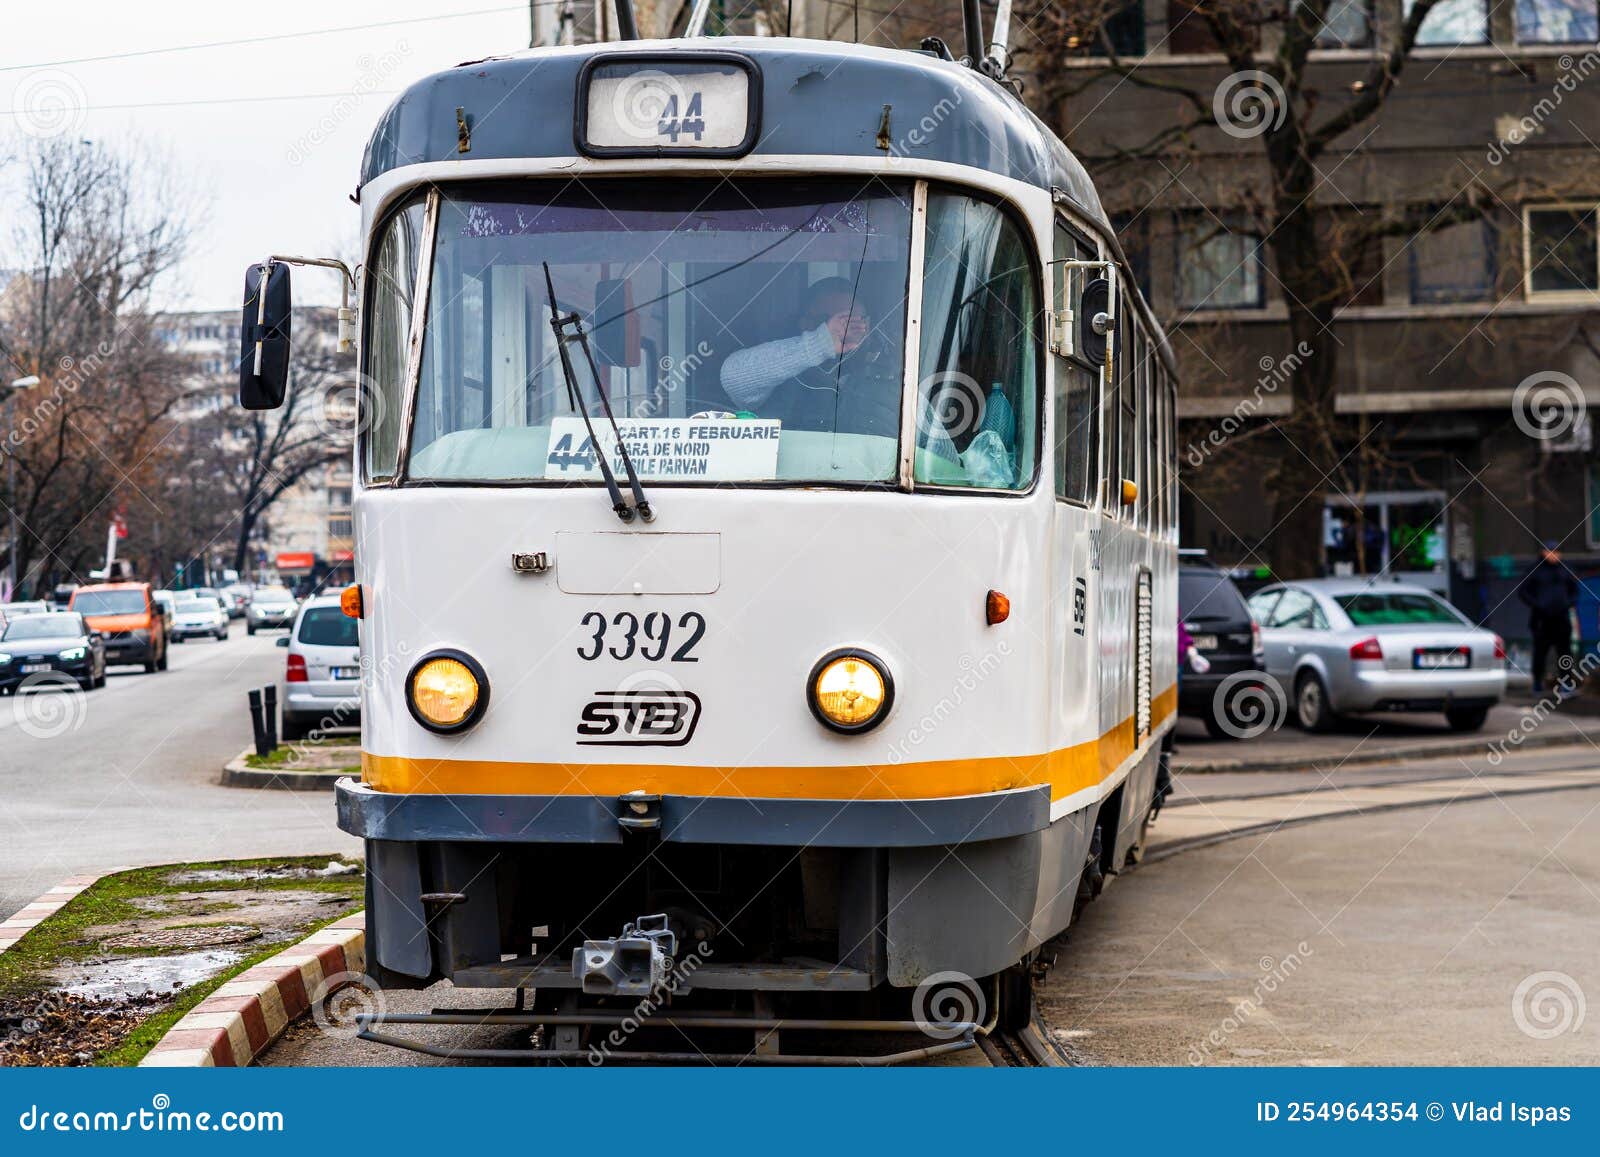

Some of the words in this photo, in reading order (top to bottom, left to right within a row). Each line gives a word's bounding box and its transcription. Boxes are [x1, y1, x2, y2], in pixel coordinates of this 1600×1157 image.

[658, 92, 705, 142] 44
[689, 427, 779, 439] FEBRUARIE
[548, 434, 597, 471] 44
[654, 443, 670, 456] DE
[674, 443, 710, 456] NORD
[659, 459, 707, 475] PARVAN
[577, 612, 706, 662] 3392
[577, 702, 688, 734] STB
